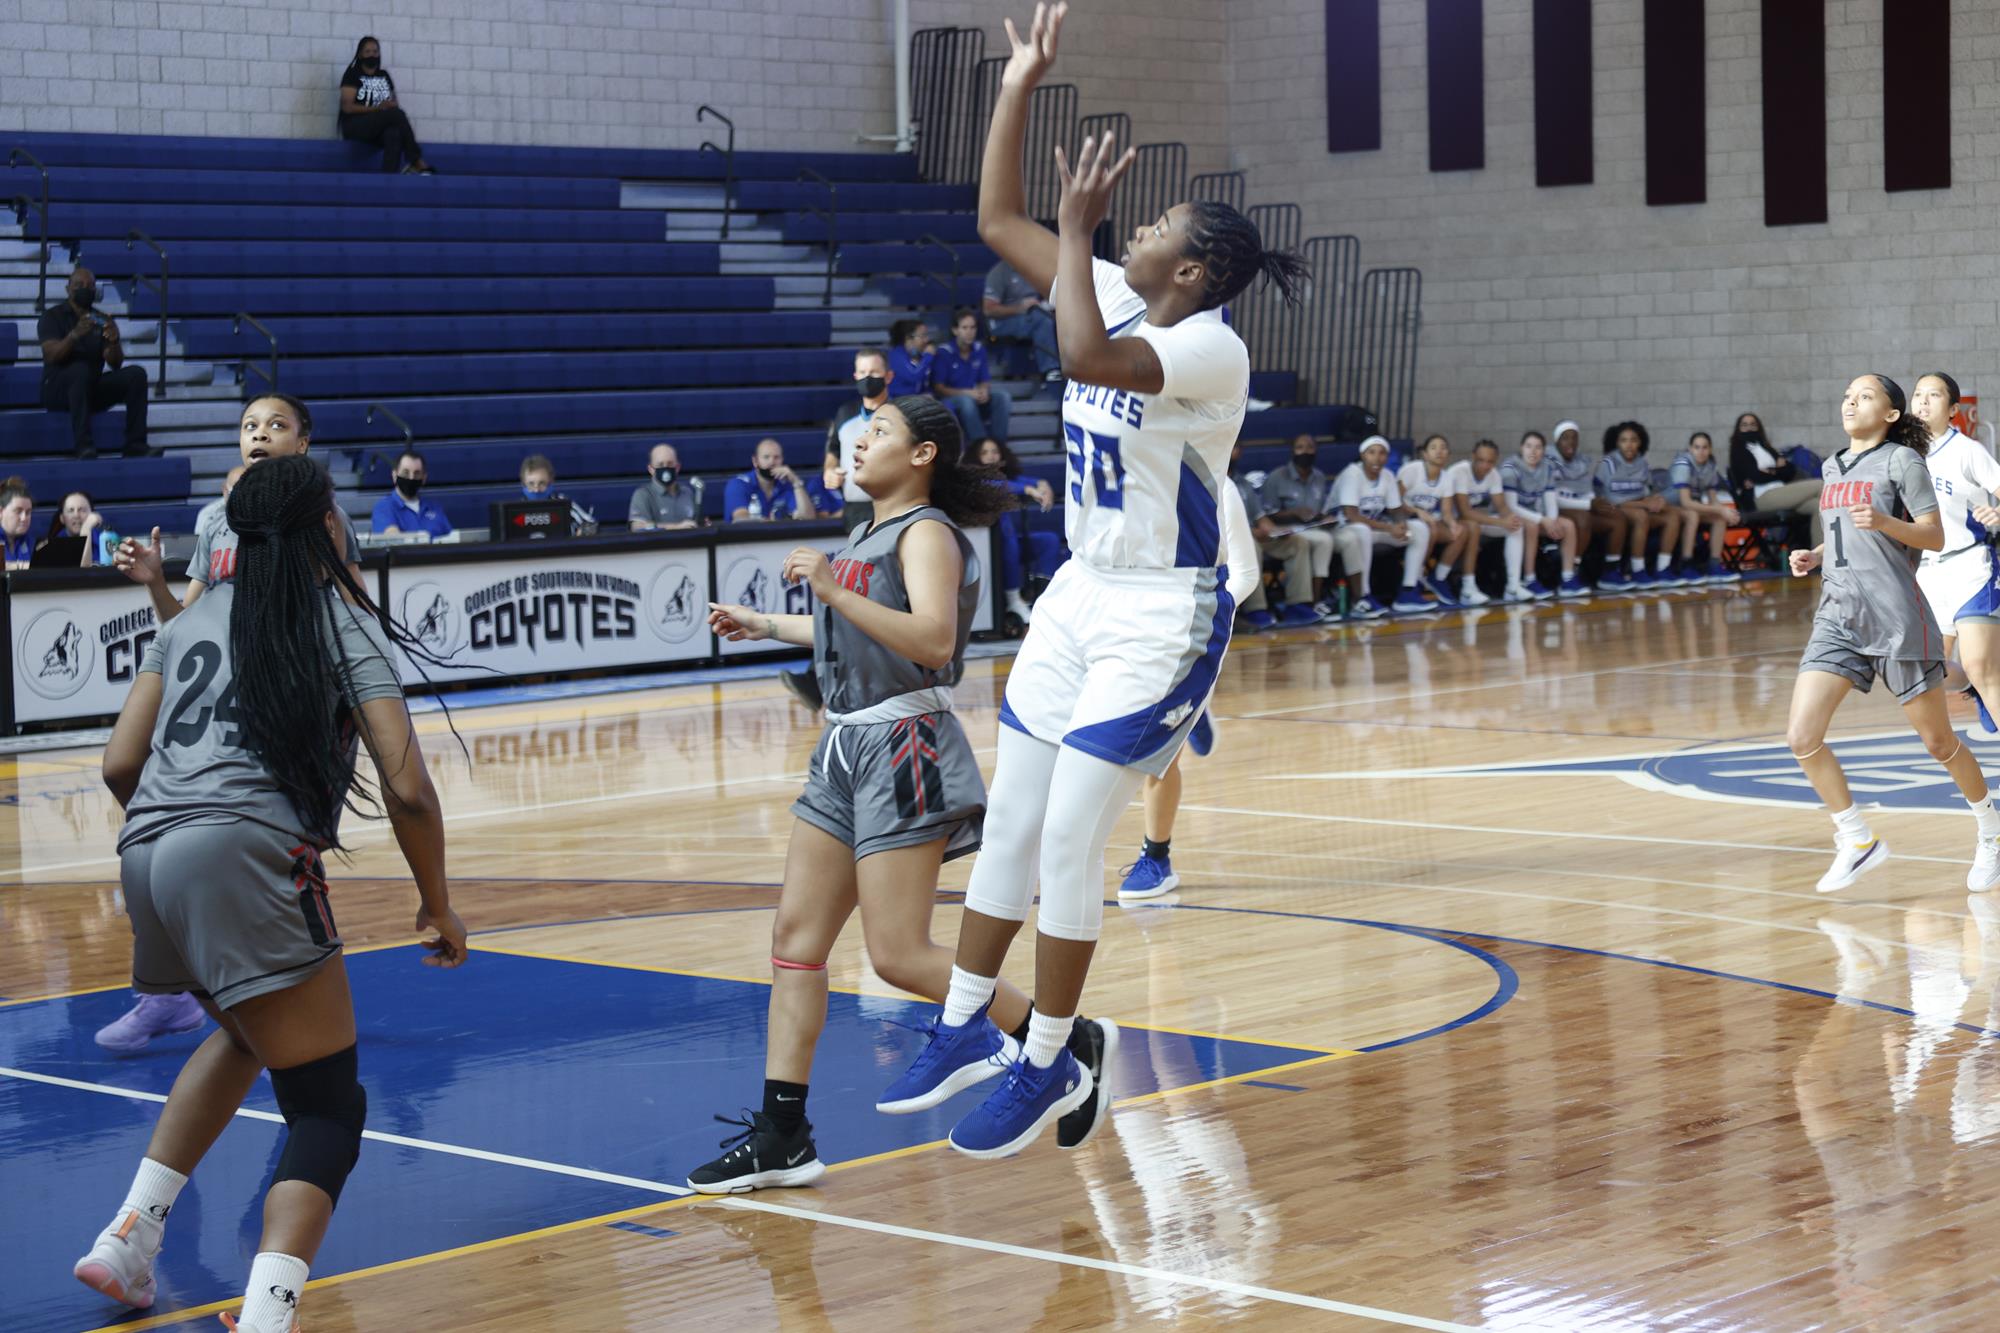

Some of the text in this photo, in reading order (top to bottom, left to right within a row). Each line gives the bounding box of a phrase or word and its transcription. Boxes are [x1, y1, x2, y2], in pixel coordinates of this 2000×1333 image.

[524, 512, 551, 526] POSS
[1830, 516, 1848, 568] 1
[465, 571, 641, 615] COLLEGE OF SOUTHERN NEVADA
[100, 606, 155, 643] COLLEGE
[470, 593, 637, 656] COYOTES
